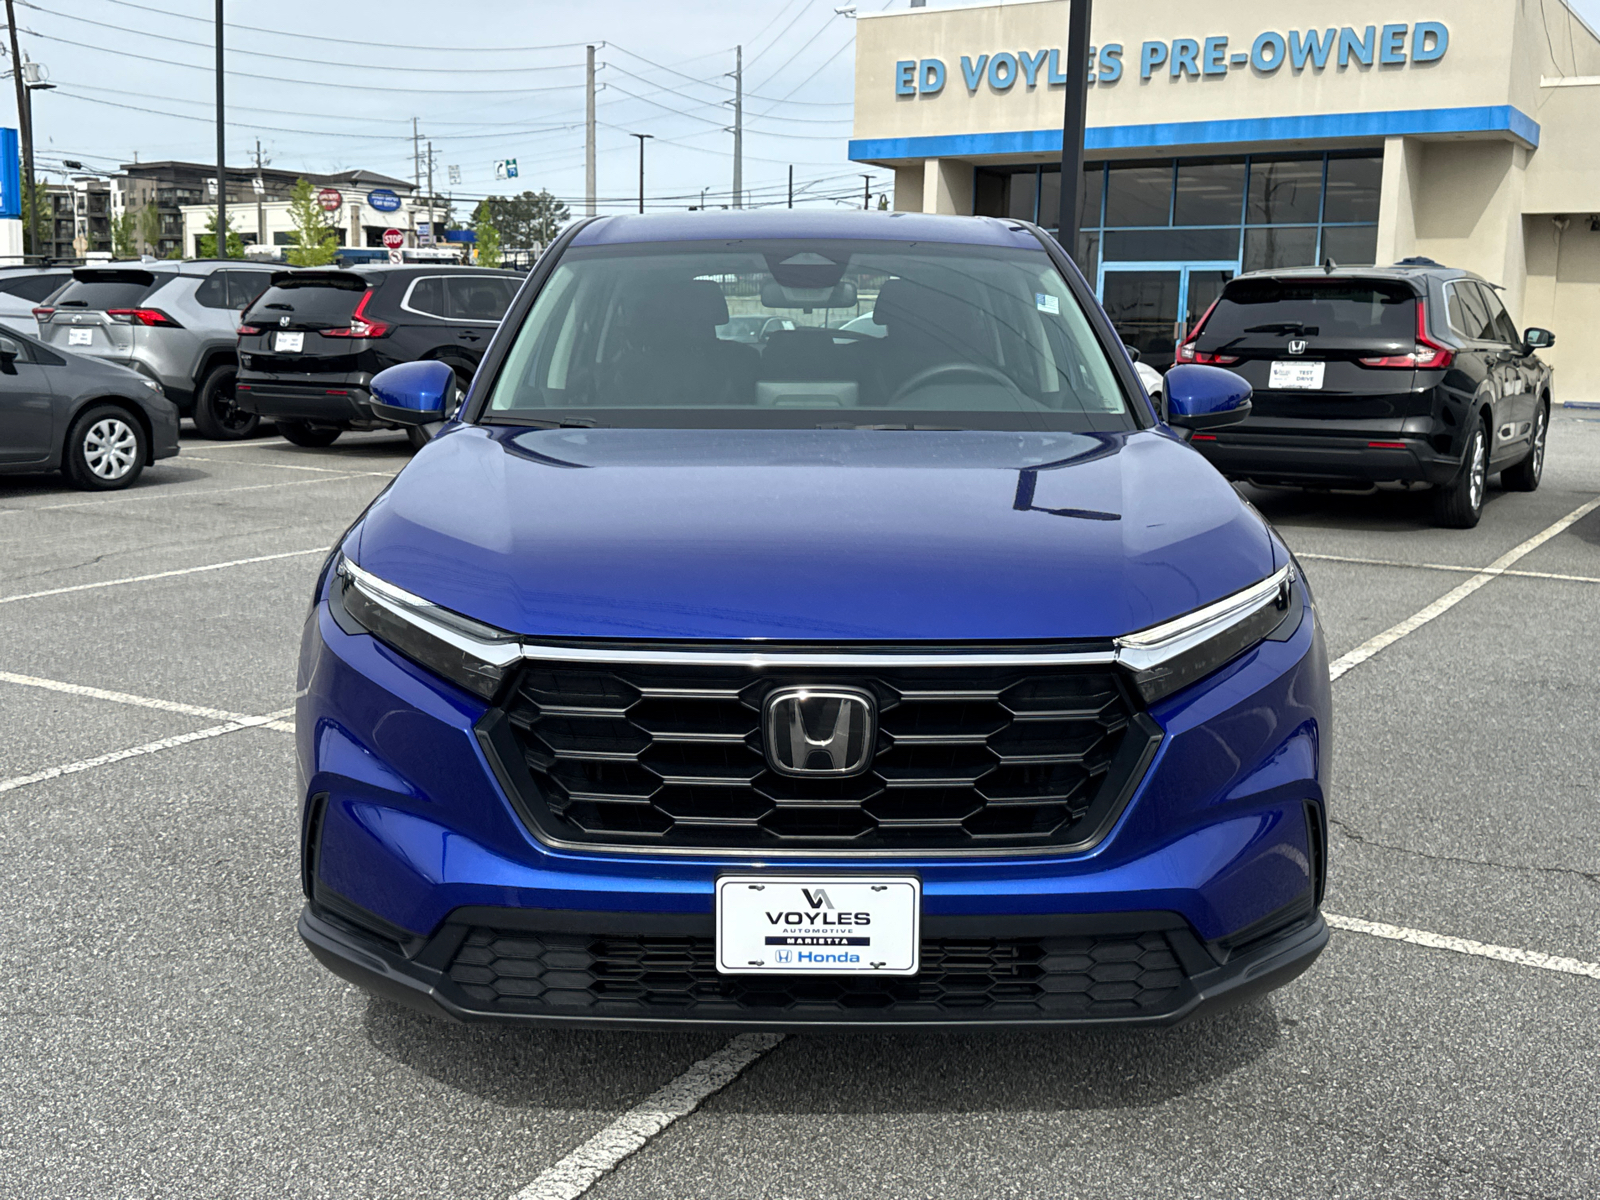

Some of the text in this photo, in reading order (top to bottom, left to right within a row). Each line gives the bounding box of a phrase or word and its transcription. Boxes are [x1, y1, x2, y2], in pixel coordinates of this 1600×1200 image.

[896, 58, 946, 95] ED
[1141, 21, 1449, 79] PRE-OWNED
[384, 235, 402, 243] STOP
[765, 911, 871, 926] VOYLES
[787, 937, 848, 945] MARIETTA
[798, 951, 860, 963] Honda
